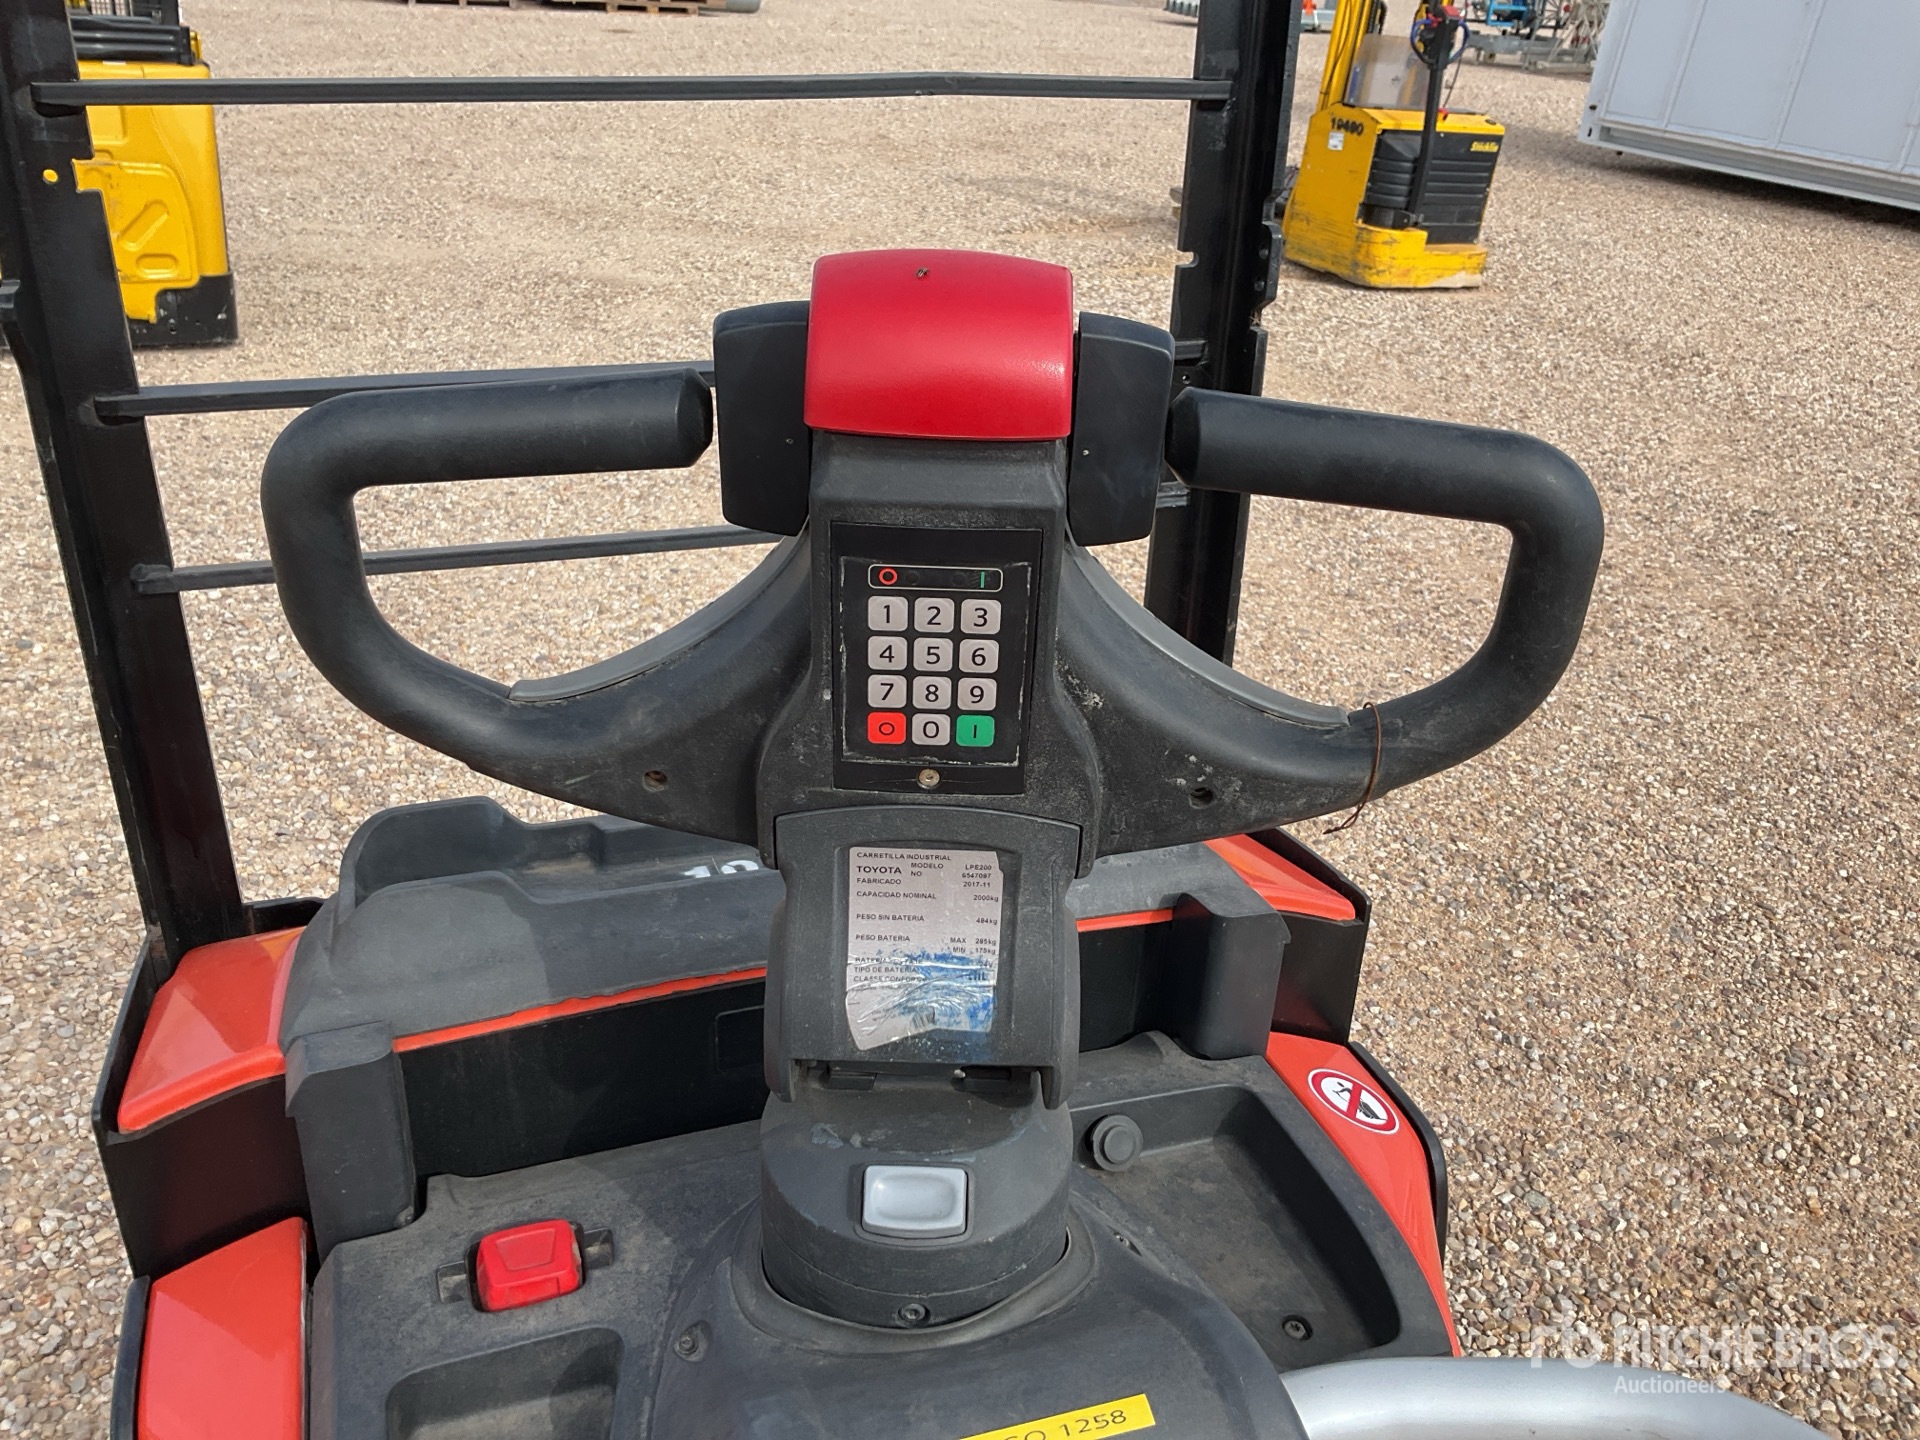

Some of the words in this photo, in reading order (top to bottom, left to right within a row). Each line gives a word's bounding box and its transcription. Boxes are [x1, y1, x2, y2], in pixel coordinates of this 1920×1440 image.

[883, 605, 891, 623] 1
[926, 606, 942, 625] 2
[973, 607, 988, 627] 3
[879, 644, 895, 663] 4
[926, 646, 941, 665] 5
[971, 647, 986, 666] 6
[880, 682, 894, 701] 7
[925, 684, 939, 702] 8
[970, 685, 984, 703] 9
[856, 852, 905, 860] CARRETILLA
[906, 853, 951, 861] INDUSTRIAL
[856, 865, 902, 874] TOYOTA
[973, 894, 999, 902] 2000kg
[976, 917, 998, 925] 484kg
[1059, 1409, 1127, 1437] 1258
